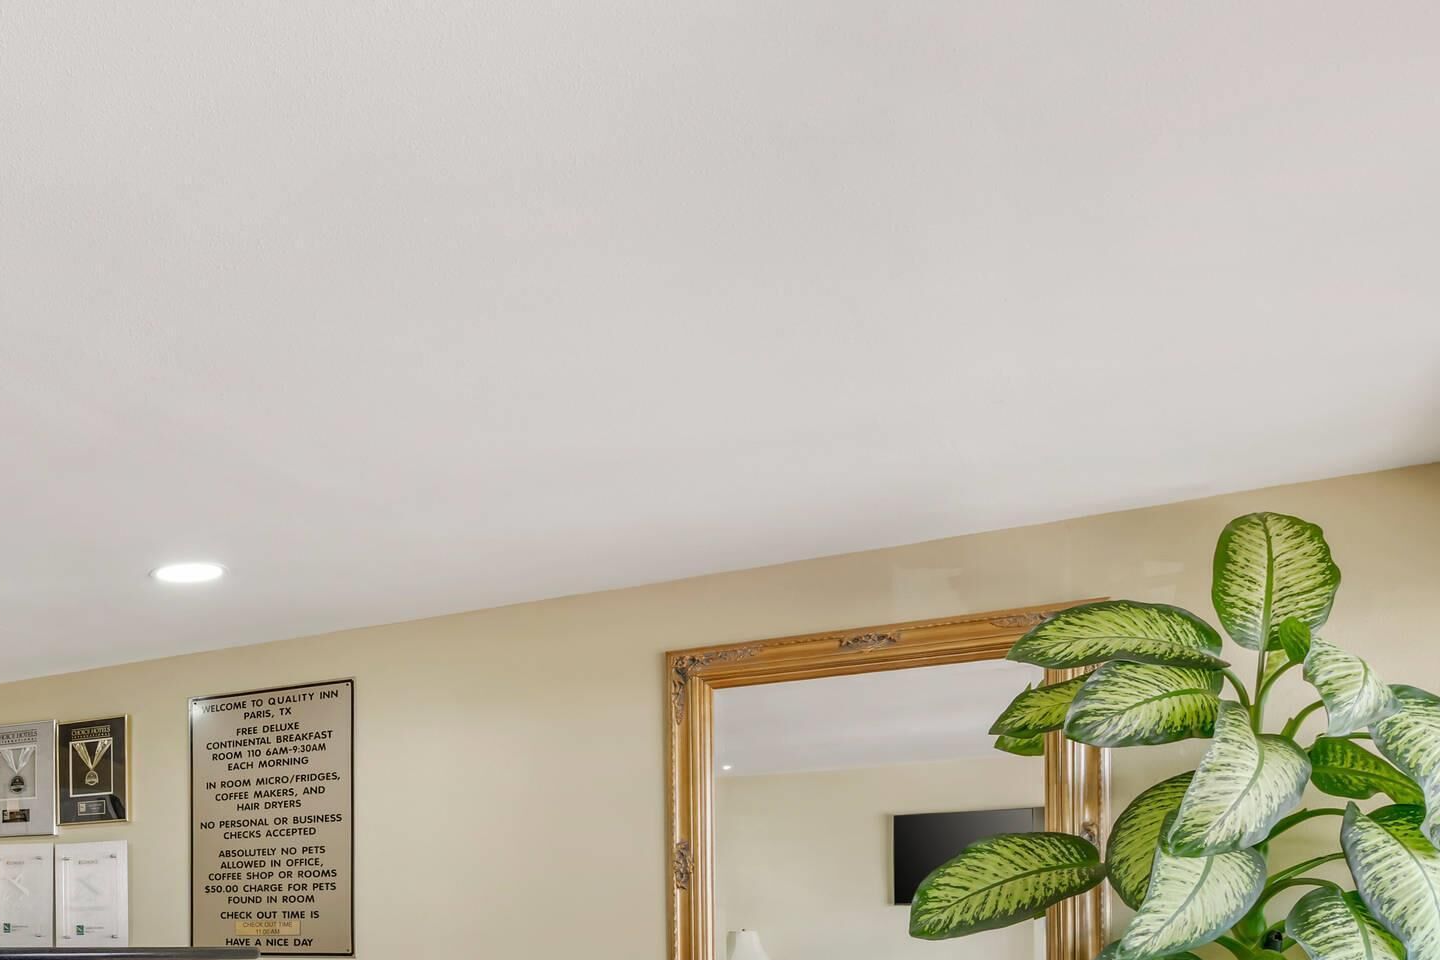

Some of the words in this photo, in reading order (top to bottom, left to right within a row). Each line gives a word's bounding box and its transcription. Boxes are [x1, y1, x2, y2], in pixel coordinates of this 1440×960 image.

[202, 701, 246, 713] WELCOME
[252, 699, 263, 707] TO
[268, 693, 314, 705] QUALITY
[320, 690, 338, 699] INN
[244, 710, 274, 719] PARIS,
[280, 708, 291, 716] TX
[237, 727, 257, 736] FREE
[263, 722, 299, 733] DELUXE
[206, 737, 271, 750] CONTINENTAL
[276, 731, 333, 743] BREAKFAST
[212, 751, 242, 760] ROOM
[266, 743, 326, 756] 6AM-9:30AM
[228, 761, 253, 770] EACH
[259, 757, 308, 768] MORNING
[221, 779, 251, 788] ROOM
[256, 772, 340, 785] MICRO/FRIDGES,
[215, 792, 248, 801] COFFEE
[254, 788, 298, 798] MAKERS,
[303, 786, 325, 794] AND
[237, 803, 259, 811] HAIR
[265, 800, 301, 809] DRYERS
[219, 818, 269, 828] PERSONAL
[274, 817, 288, 825] OR
[293, 814, 342, 824] BUSINESS
[224, 830, 261, 839] CHECKS
[266, 828, 316, 837] ACCEPTED
[219, 848, 276, 857] ABSOLUTELY
[302, 846, 325, 854] PETS
[221, 860, 266, 869] ALLOWED
[286, 858, 323, 867] OFFICE,
[208, 873, 241, 881] COFFEE
[246, 872, 274, 880] SHOP
[298, 869, 336, 878] ROOMS
[205, 885, 238, 893] $50.00
[243, 884, 282, 892] CHARGE
[288, 883, 307, 891] FOR
[228, 896, 262, 904] FOUND
[282, 895, 315, 903] ROOM
